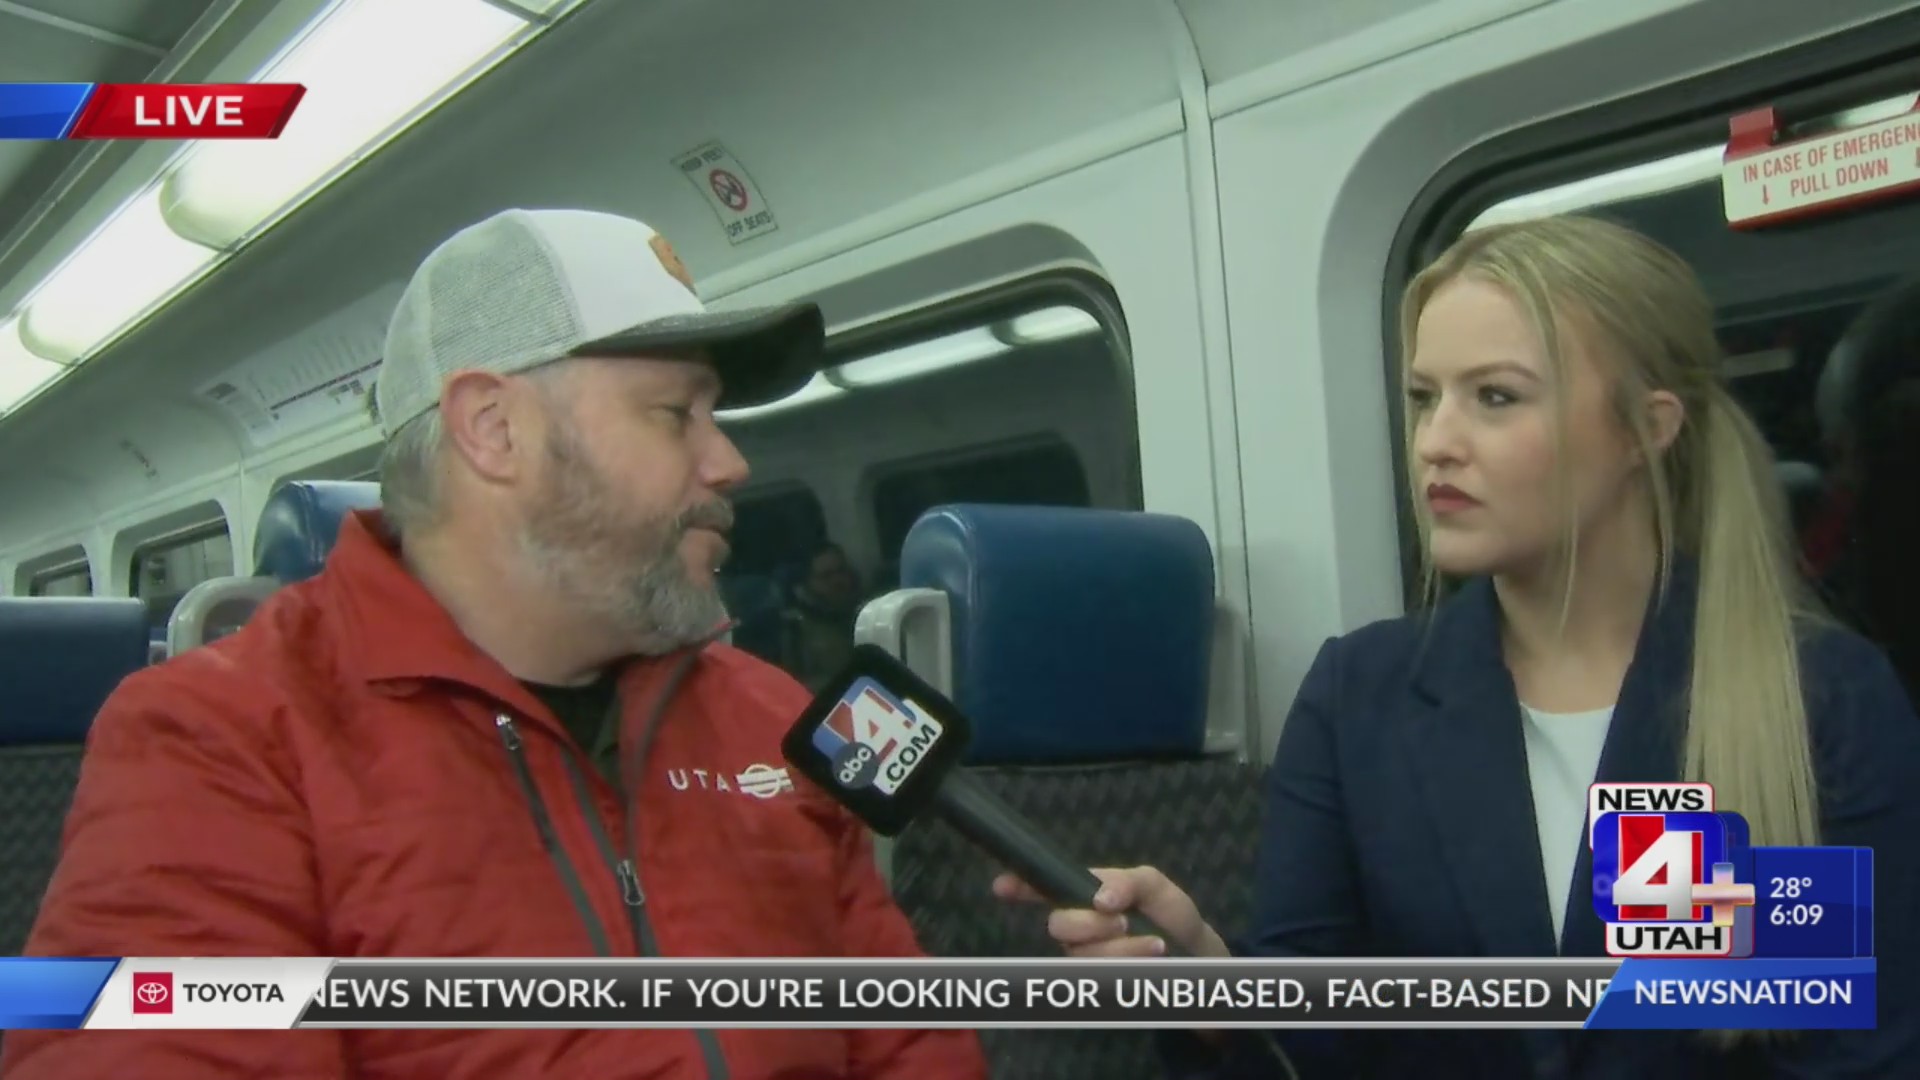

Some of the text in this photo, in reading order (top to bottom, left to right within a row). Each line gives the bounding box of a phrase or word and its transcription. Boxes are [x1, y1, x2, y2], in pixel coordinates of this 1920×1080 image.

[1743, 122, 1920, 184] IN CASE OF EMERGEN
[1790, 157, 1889, 197] PULL DOWN
[668, 768, 732, 793] UTA
[839, 746, 872, 783] abc
